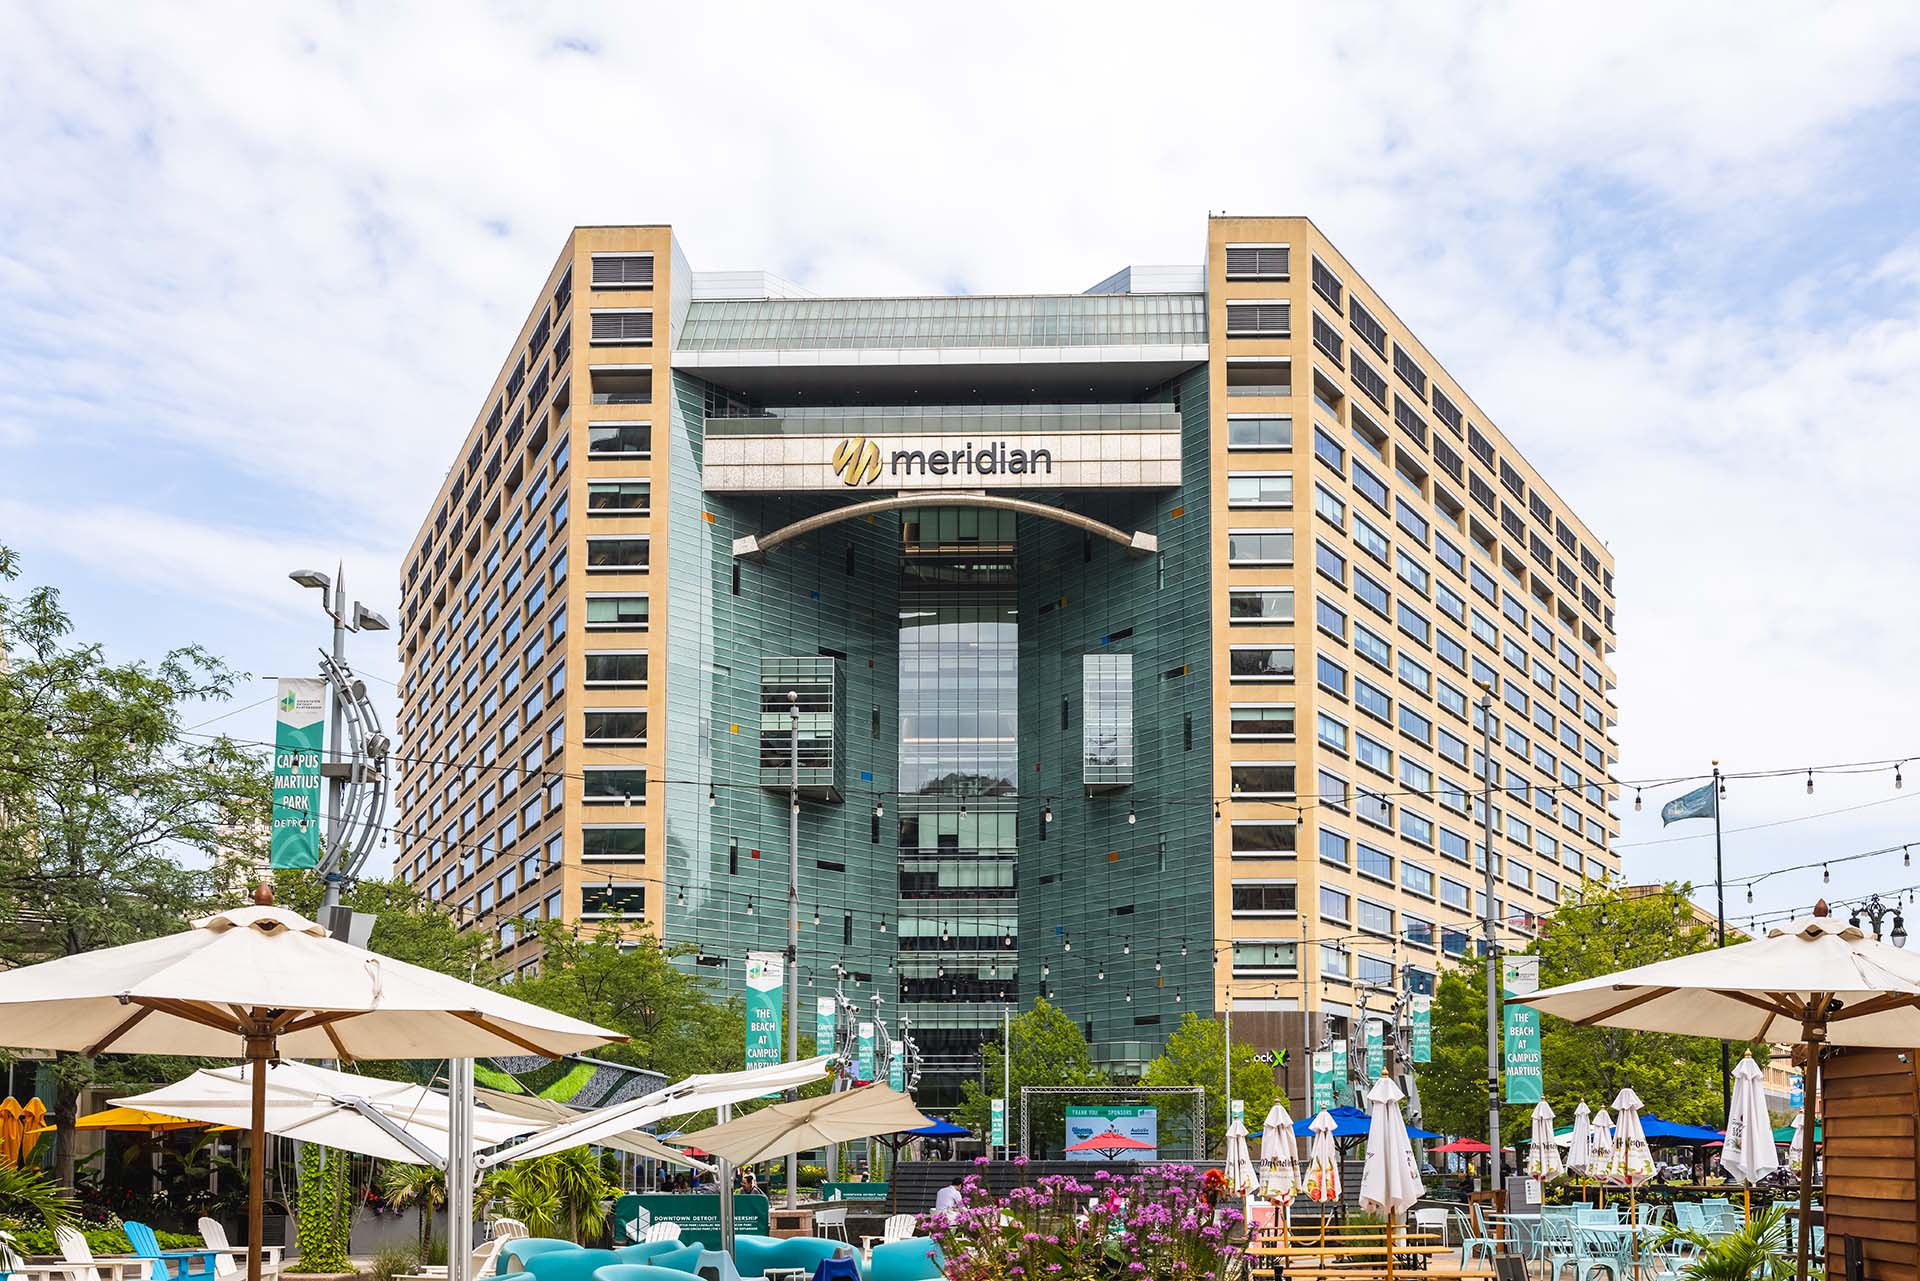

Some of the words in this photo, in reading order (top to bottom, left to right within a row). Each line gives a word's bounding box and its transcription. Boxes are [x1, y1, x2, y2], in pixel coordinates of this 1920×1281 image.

[891, 441, 1052, 475] meridian
[276, 754, 319, 769] CAMPUS
[274, 775, 319, 789] MARTIUS
[282, 795, 309, 810] PARK
[756, 1009, 771, 1018] THE
[1514, 1013, 1529, 1023] THE
[751, 1022, 776, 1031] BEACH
[1510, 1026, 1534, 1036] BEACH
[758, 1035, 768, 1044] AT
[1518, 1040, 1527, 1049] AT
[747, 1049, 778, 1058] CAMPUS
[1244, 1048, 1287, 1067] ockX
[1507, 1053, 1538, 1063] CAMPUS
[1506, 1066, 1540, 1076] MARTIUS
